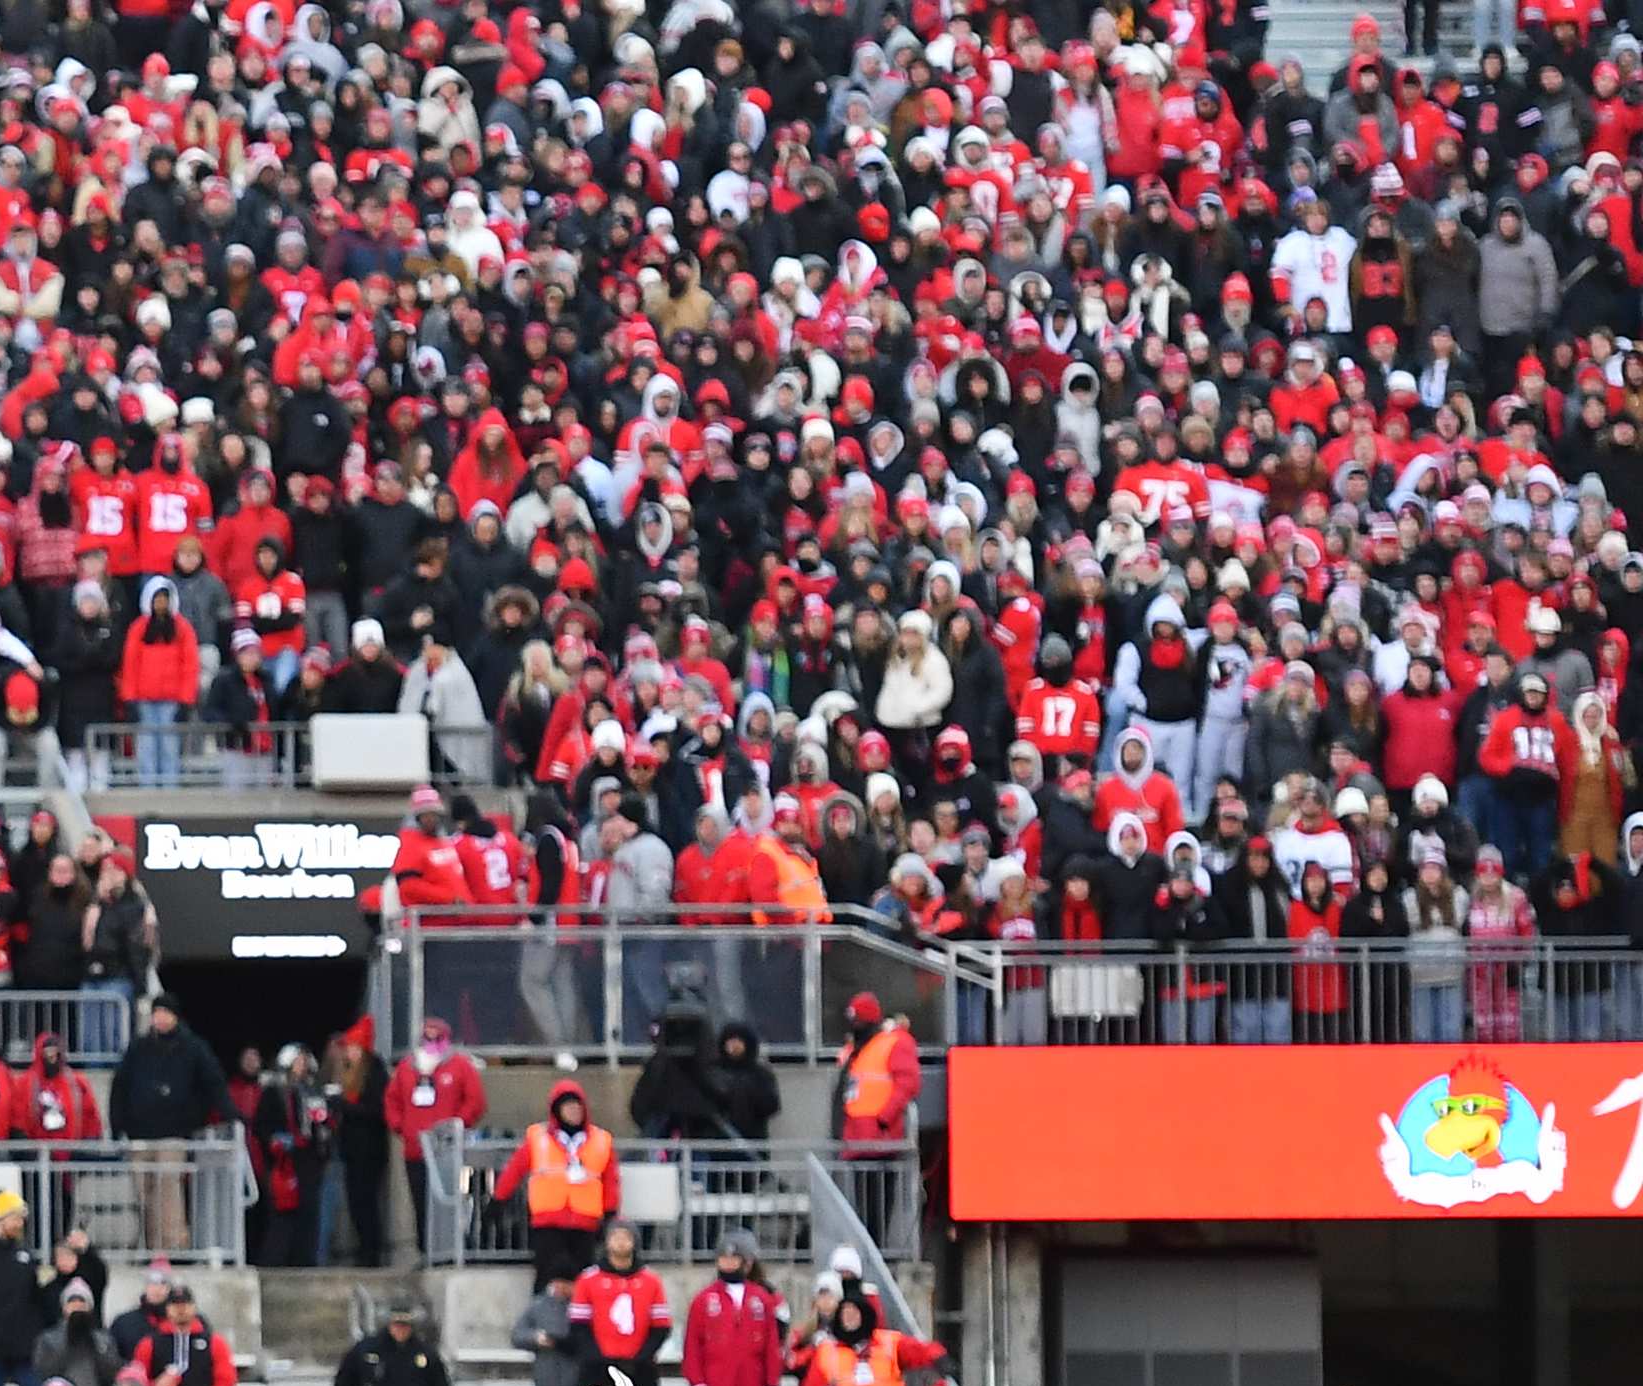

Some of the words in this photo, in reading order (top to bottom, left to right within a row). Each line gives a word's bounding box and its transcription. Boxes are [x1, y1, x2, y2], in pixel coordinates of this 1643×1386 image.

[86, 496, 124, 534] 15
[149, 493, 188, 531] 15
[1042, 696, 1075, 734] 17
[144, 824, 264, 869] Evan
[609, 1294, 635, 1334] 4
